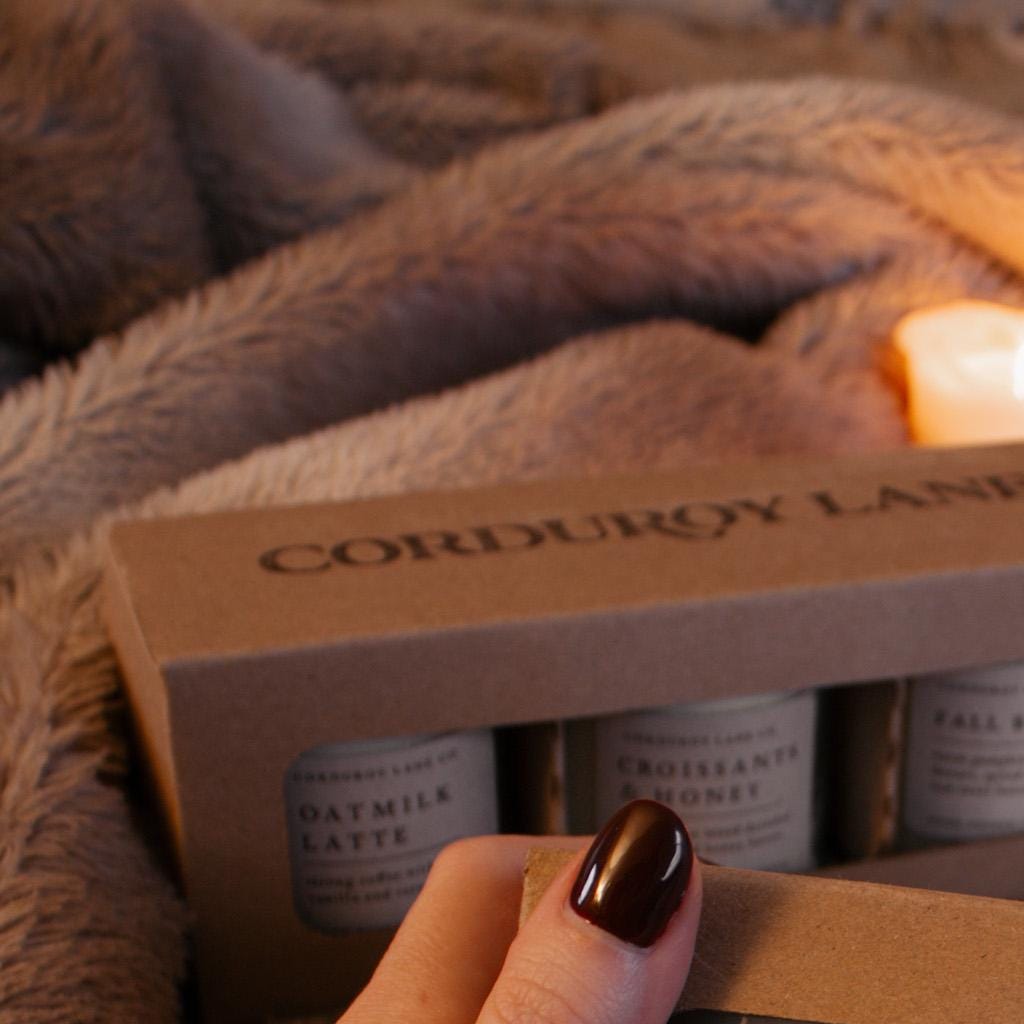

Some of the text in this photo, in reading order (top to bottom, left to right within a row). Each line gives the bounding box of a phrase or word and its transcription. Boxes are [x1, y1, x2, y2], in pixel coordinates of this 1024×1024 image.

[258, 494, 787, 573] CORDUROY
[299, 785, 451, 822] OATMILK
[302, 825, 408, 851] LATTE
